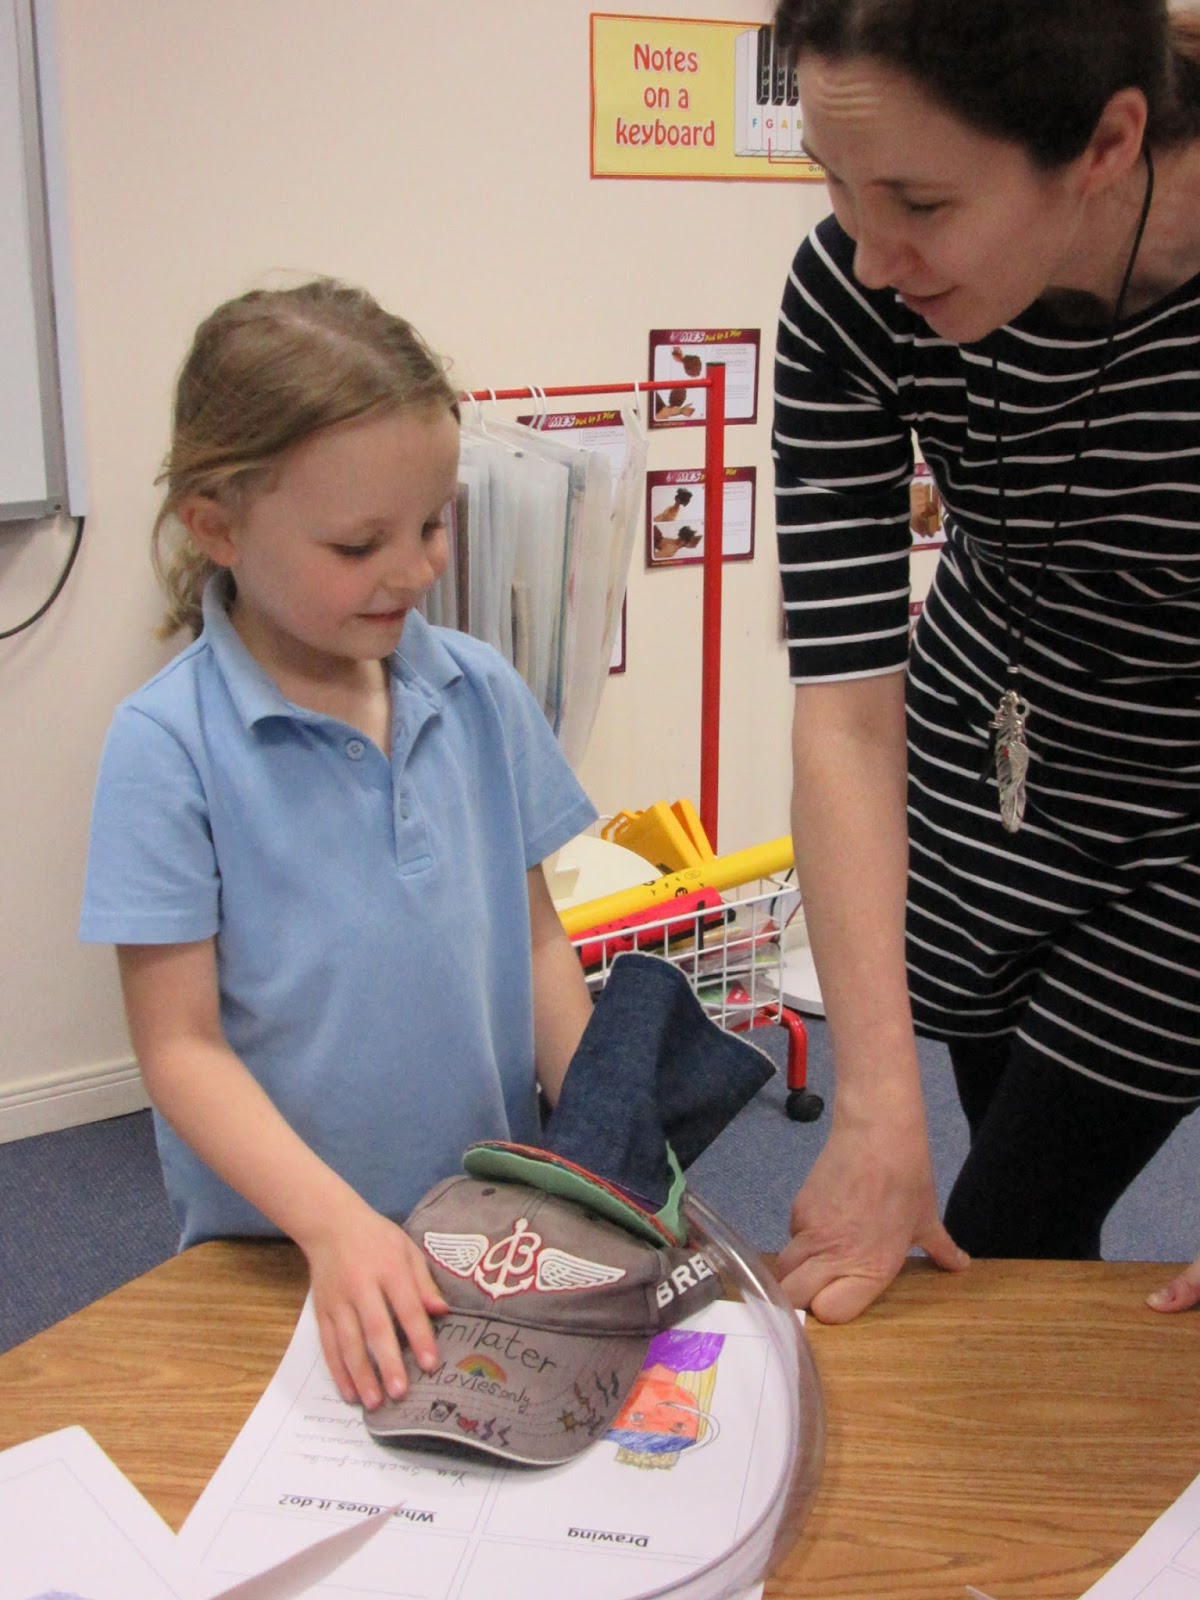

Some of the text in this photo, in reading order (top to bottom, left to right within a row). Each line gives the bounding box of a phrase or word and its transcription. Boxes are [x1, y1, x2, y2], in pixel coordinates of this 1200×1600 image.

[633, 43, 698, 73] Notes
[643, 87, 689, 110] on a
[615, 117, 715, 147] keyboard
[752, 118, 803, 129] F G A B
[434, 1320, 557, 1374] rnilater
[418, 1361, 500, 1395] Movies
[278, 1496, 436, 1523] Wha does it do?
[567, 1527, 650, 1548] Drawing
